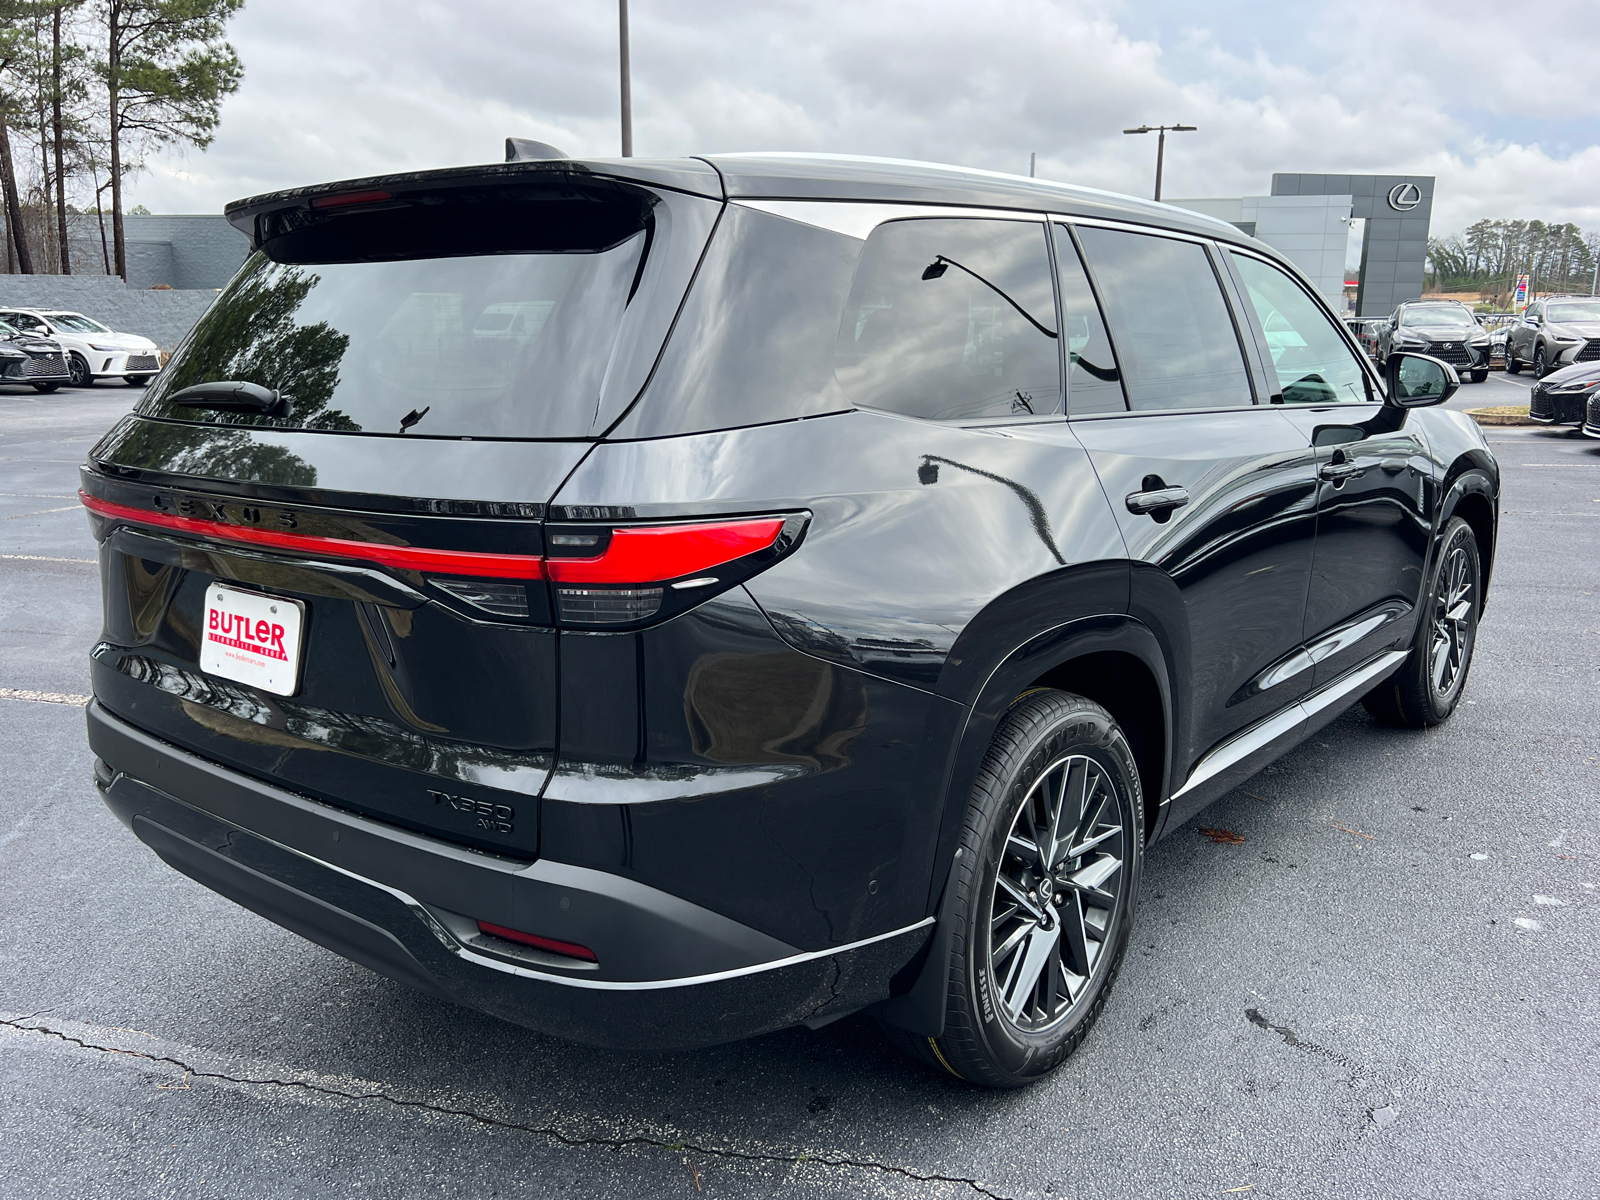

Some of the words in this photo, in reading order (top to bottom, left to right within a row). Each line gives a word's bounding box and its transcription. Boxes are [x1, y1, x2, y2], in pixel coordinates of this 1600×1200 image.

[153, 495, 298, 529] LEXUS
[225, 651, 266, 668] www.butlercars.com
[260, 647, 286, 660] GROUP
[1003, 720, 1097, 825] GOODYEAR
[426, 788, 516, 821] TX350
[474, 817, 515, 835] AWD
[978, 967, 995, 1024] FINESSE
